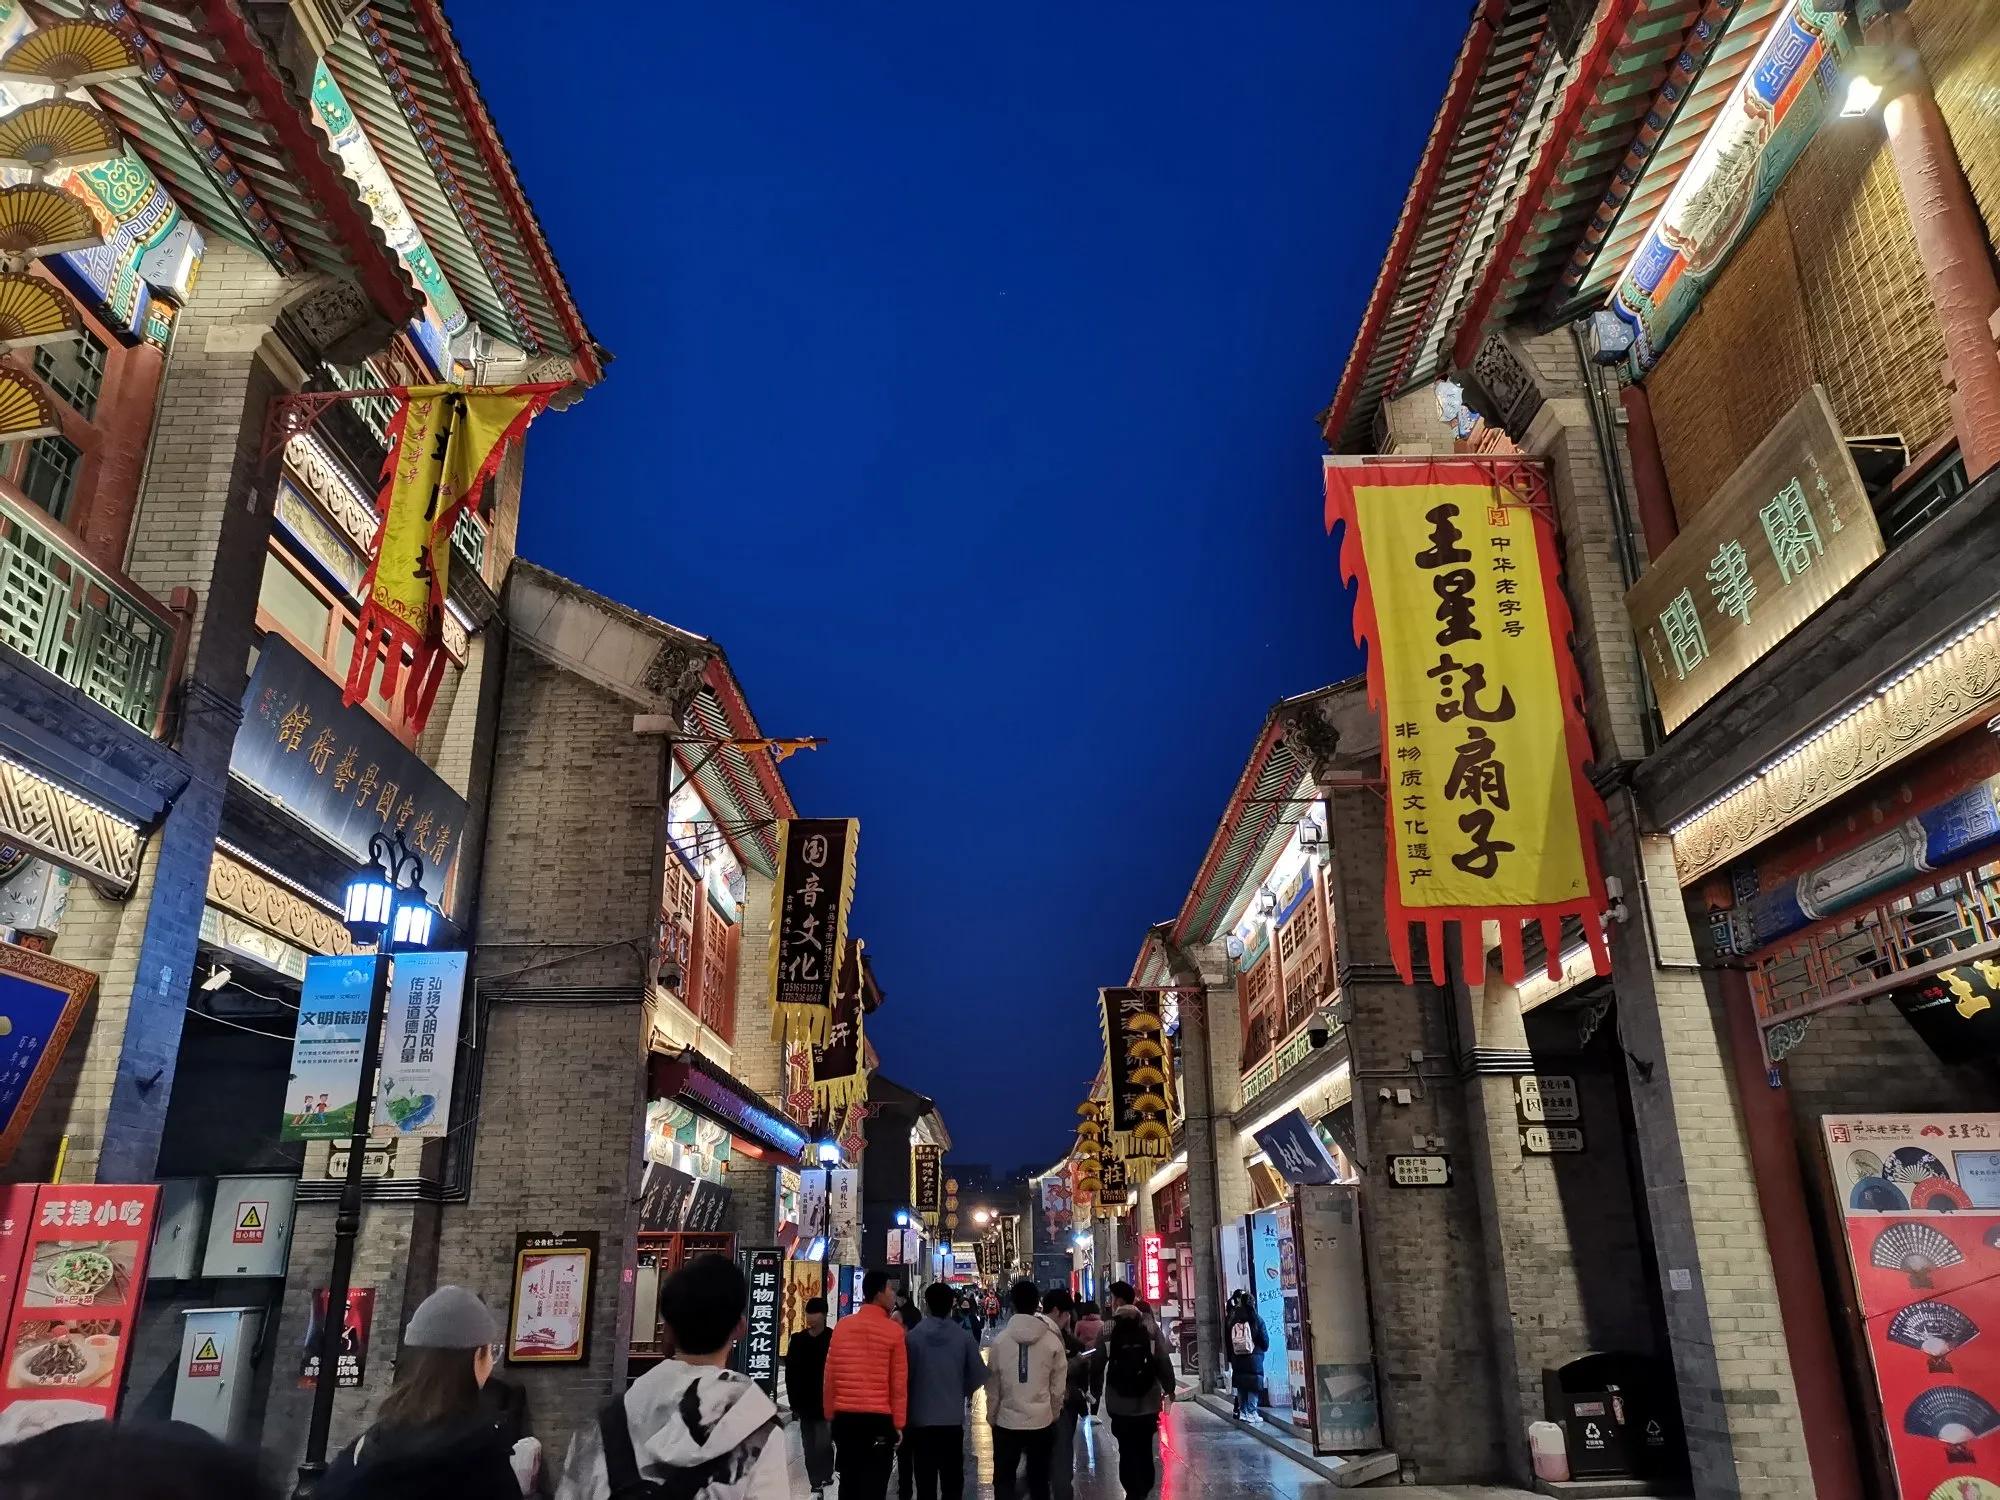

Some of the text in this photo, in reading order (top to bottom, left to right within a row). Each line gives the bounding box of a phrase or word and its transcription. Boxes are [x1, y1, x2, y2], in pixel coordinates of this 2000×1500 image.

[1490, 537, 1525, 637] 中华老字号
[1395, 722, 1432, 885] 非物质文化遗产
[301, 1011, 368, 1026] 文明旅游
[400, 976, 424, 1063] 传递道德力量
[418, 976, 442, 1062] 弘扬文明风尚
[1854, 1121, 1912, 1135] 中华老字号
[40, 1199, 145, 1227] 天津小吃
[235, 1230, 263, 1239] 当心触电
[534, 1238, 554, 1246] 公告栏
[191, 1363, 220, 1372] 当心触电
